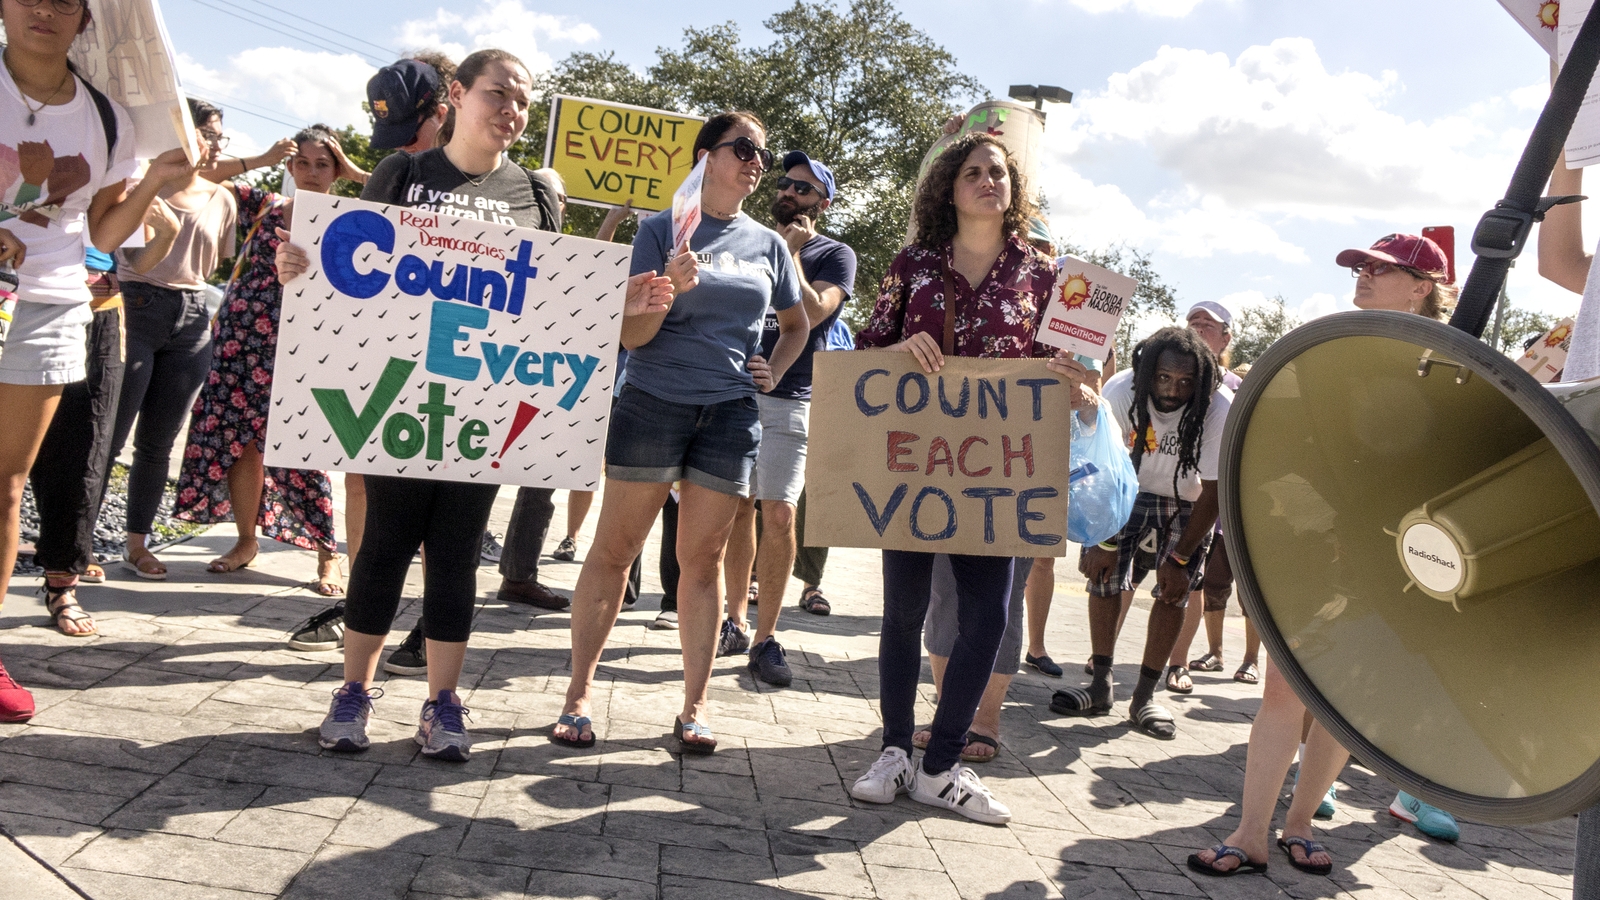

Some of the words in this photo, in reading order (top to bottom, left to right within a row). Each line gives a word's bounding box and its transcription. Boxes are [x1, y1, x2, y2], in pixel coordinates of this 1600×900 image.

[577, 105, 685, 142] COUNT
[565, 130, 683, 176] EVERY
[406, 183, 424, 203] If
[426, 189, 469, 206] you
[474, 196, 510, 213] are
[584, 168, 662, 200] VOTE
[400, 210, 439, 228] Real
[410, 202, 485, 221] eutral
[420, 228, 506, 261] Democracies
[321, 209, 538, 316] Count
[1087, 298, 1123, 317] MAJORITY
[1091, 288, 1123, 306] FLORIDA
[1049, 320, 1106, 344] #BRINGITHOME
[425, 300, 600, 411] Every
[854, 368, 1060, 421] COUNT
[311, 356, 541, 469] Vote!
[886, 430, 1035, 478] EACH
[852, 481, 1062, 545] VOTE
[1408, 546, 1456, 570] RadioShack
